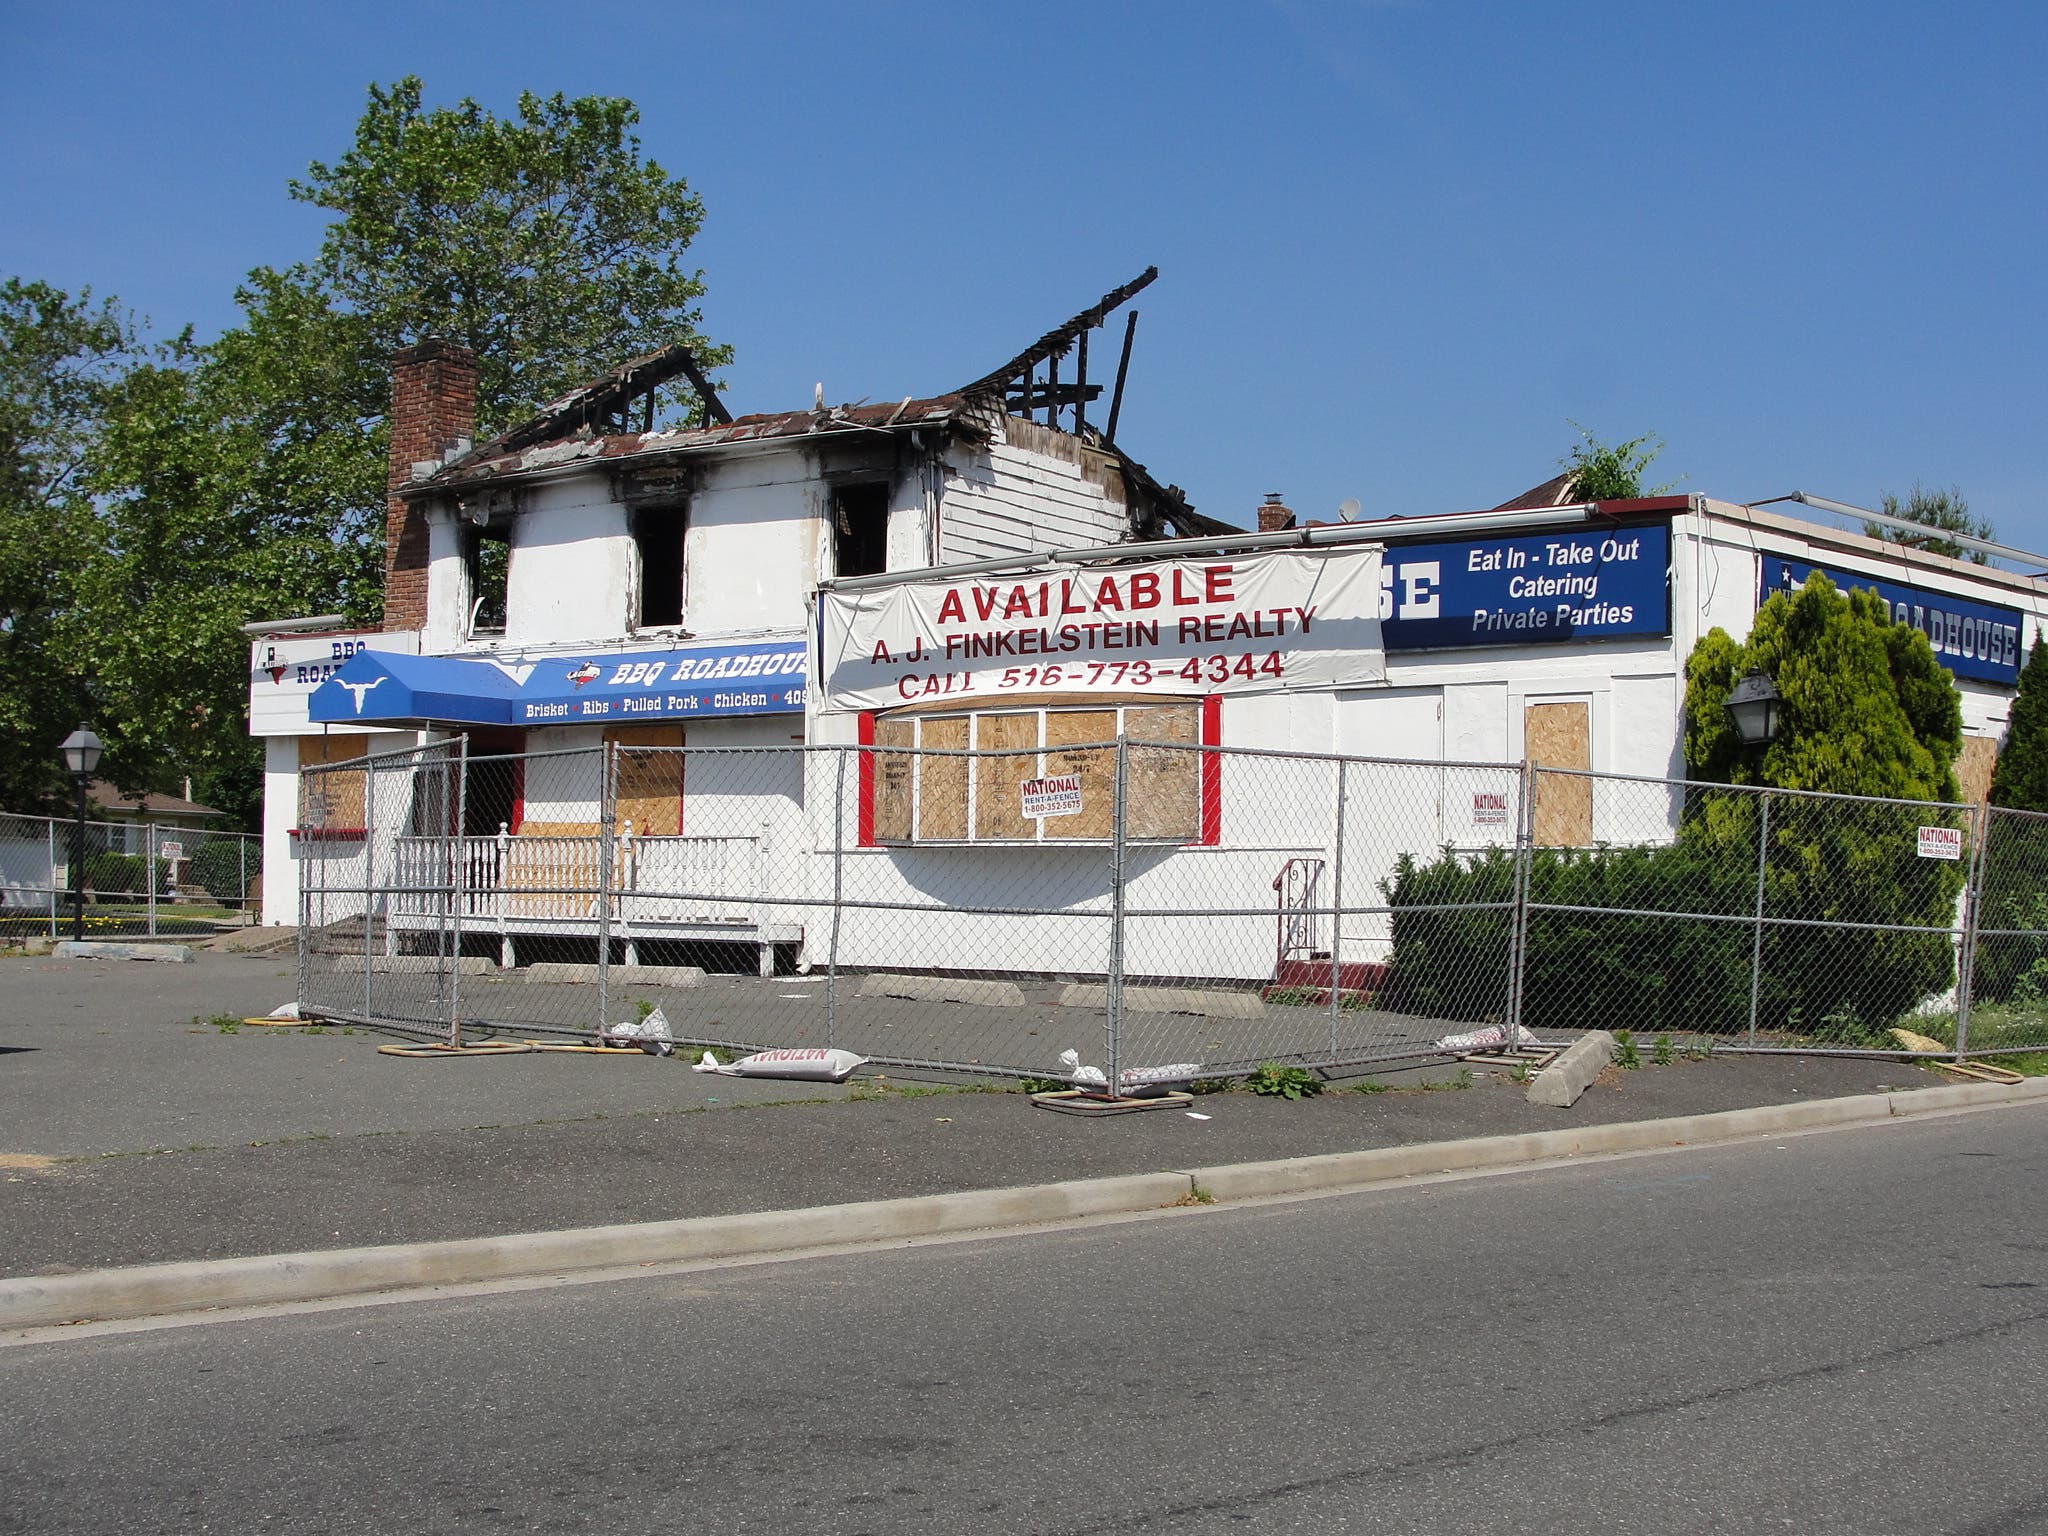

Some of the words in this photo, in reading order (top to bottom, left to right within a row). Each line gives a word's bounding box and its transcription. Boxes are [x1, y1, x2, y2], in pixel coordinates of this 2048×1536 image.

[1468, 549, 1503, 572] Eat
[1506, 547, 1526, 569] In
[1546, 543, 1593, 566] Take
[1601, 538, 1639, 563] Out
[937, 565, 1236, 625] AVAILABLE
[1509, 573, 1598, 599] Catering
[1472, 607, 1548, 632] Private
[1555, 602, 1633, 627] Parties
[871, 639, 899, 665] A.
[904, 638, 930, 662] J.
[945, 619, 1159, 661] FINKELSTEIN
[1178, 605, 1319, 645] REALTY
[608, 661, 666, 687] BBQ
[898, 671, 975, 701] CALL
[997, 650, 1285, 689] 516-773-4344
[526, 702, 569, 719] Brisket
[582, 700, 609, 715] Ribs
[623, 696, 662, 712] Pulled
[667, 695, 699, 710] Pork
[714, 692, 767, 708] Chicken
[1022, 777, 1079, 796] NATIONAL
[1024, 792, 1080, 805] RENT-A-FENCE
[1024, 800, 1081, 814] 1-800-352-5675
[1474, 794, 1506, 810] NATIONAL
[1919, 828, 1959, 844] NATIONAL
